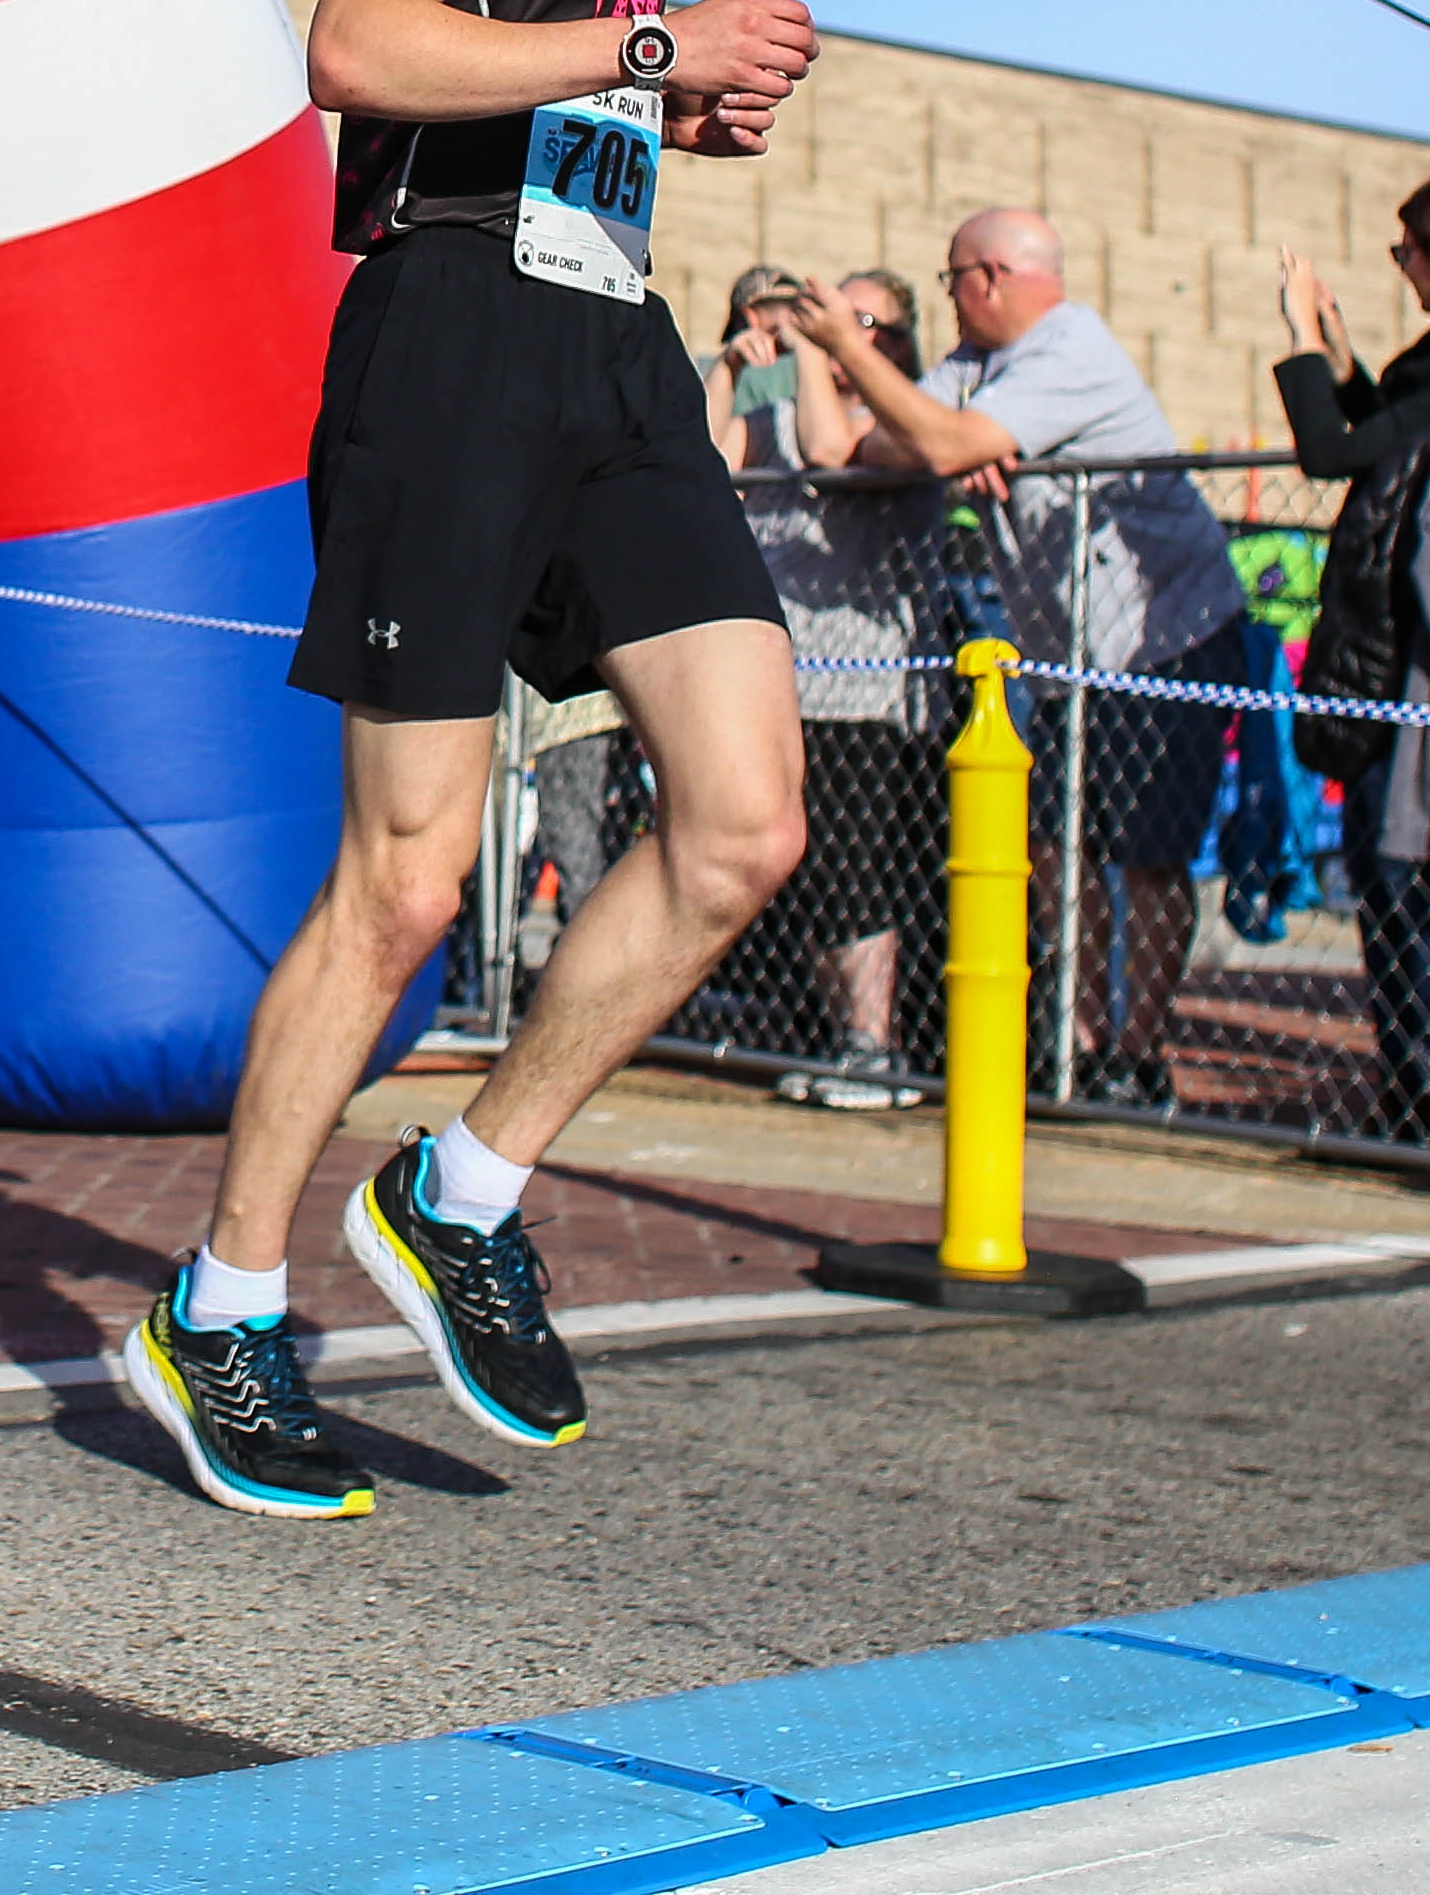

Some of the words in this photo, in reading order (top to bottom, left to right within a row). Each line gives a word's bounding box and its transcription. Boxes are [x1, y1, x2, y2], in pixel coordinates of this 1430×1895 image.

[617, 96, 644, 120] RUN
[552, 119, 650, 217] 705
[538, 252, 558, 267] GEAR
[558, 256, 584, 273] CHECK
